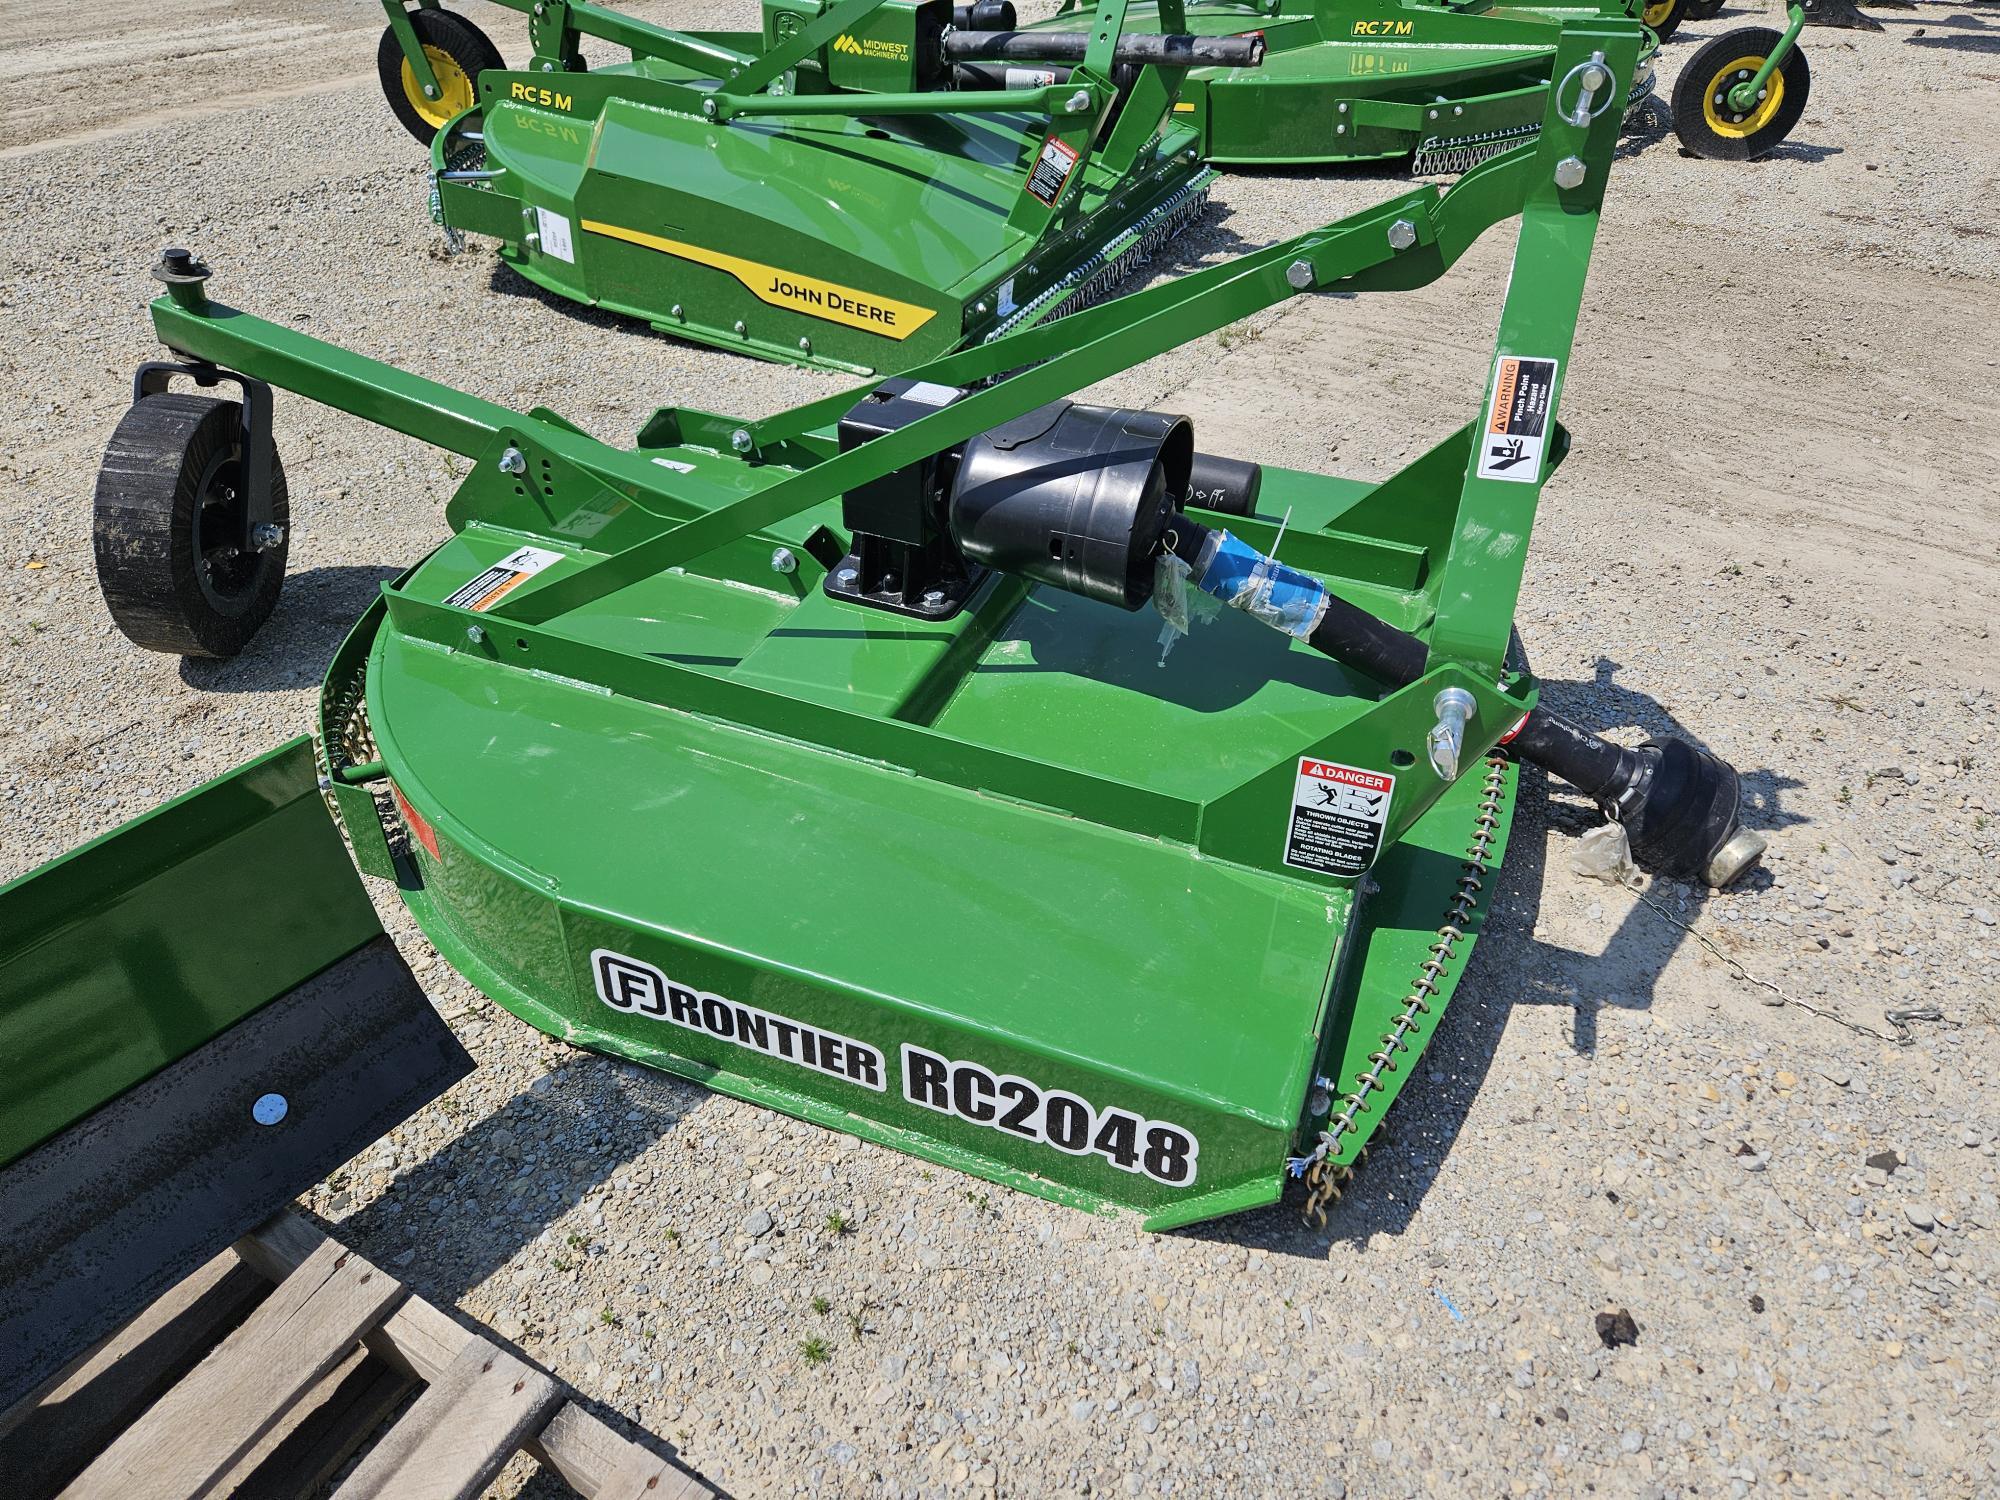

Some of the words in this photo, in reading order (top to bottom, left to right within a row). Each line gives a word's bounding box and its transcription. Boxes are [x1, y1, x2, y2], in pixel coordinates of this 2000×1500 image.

[863, 39, 908, 53] MIDWEST
[863, 49, 898, 60] MACHINERY
[769, 277, 822, 305] JOHN
[827, 291, 896, 326] DEERE
[1498, 364, 1515, 420] WARNING
[1518, 374, 1530, 397] Point
[1527, 383, 1539, 412] Hazard
[1514, 398, 1526, 422] Pinch
[1326, 767, 1384, 788] DANGER
[1305, 810, 1336, 821] THROWN
[1336, 817, 1368, 829] OBJECTS
[1300, 843, 1333, 855] ROTATING
[1334, 851, 1361, 861] BLADES
[599, 956, 878, 1086] FRONTIER
[908, 1051, 1190, 1182] RC2048
